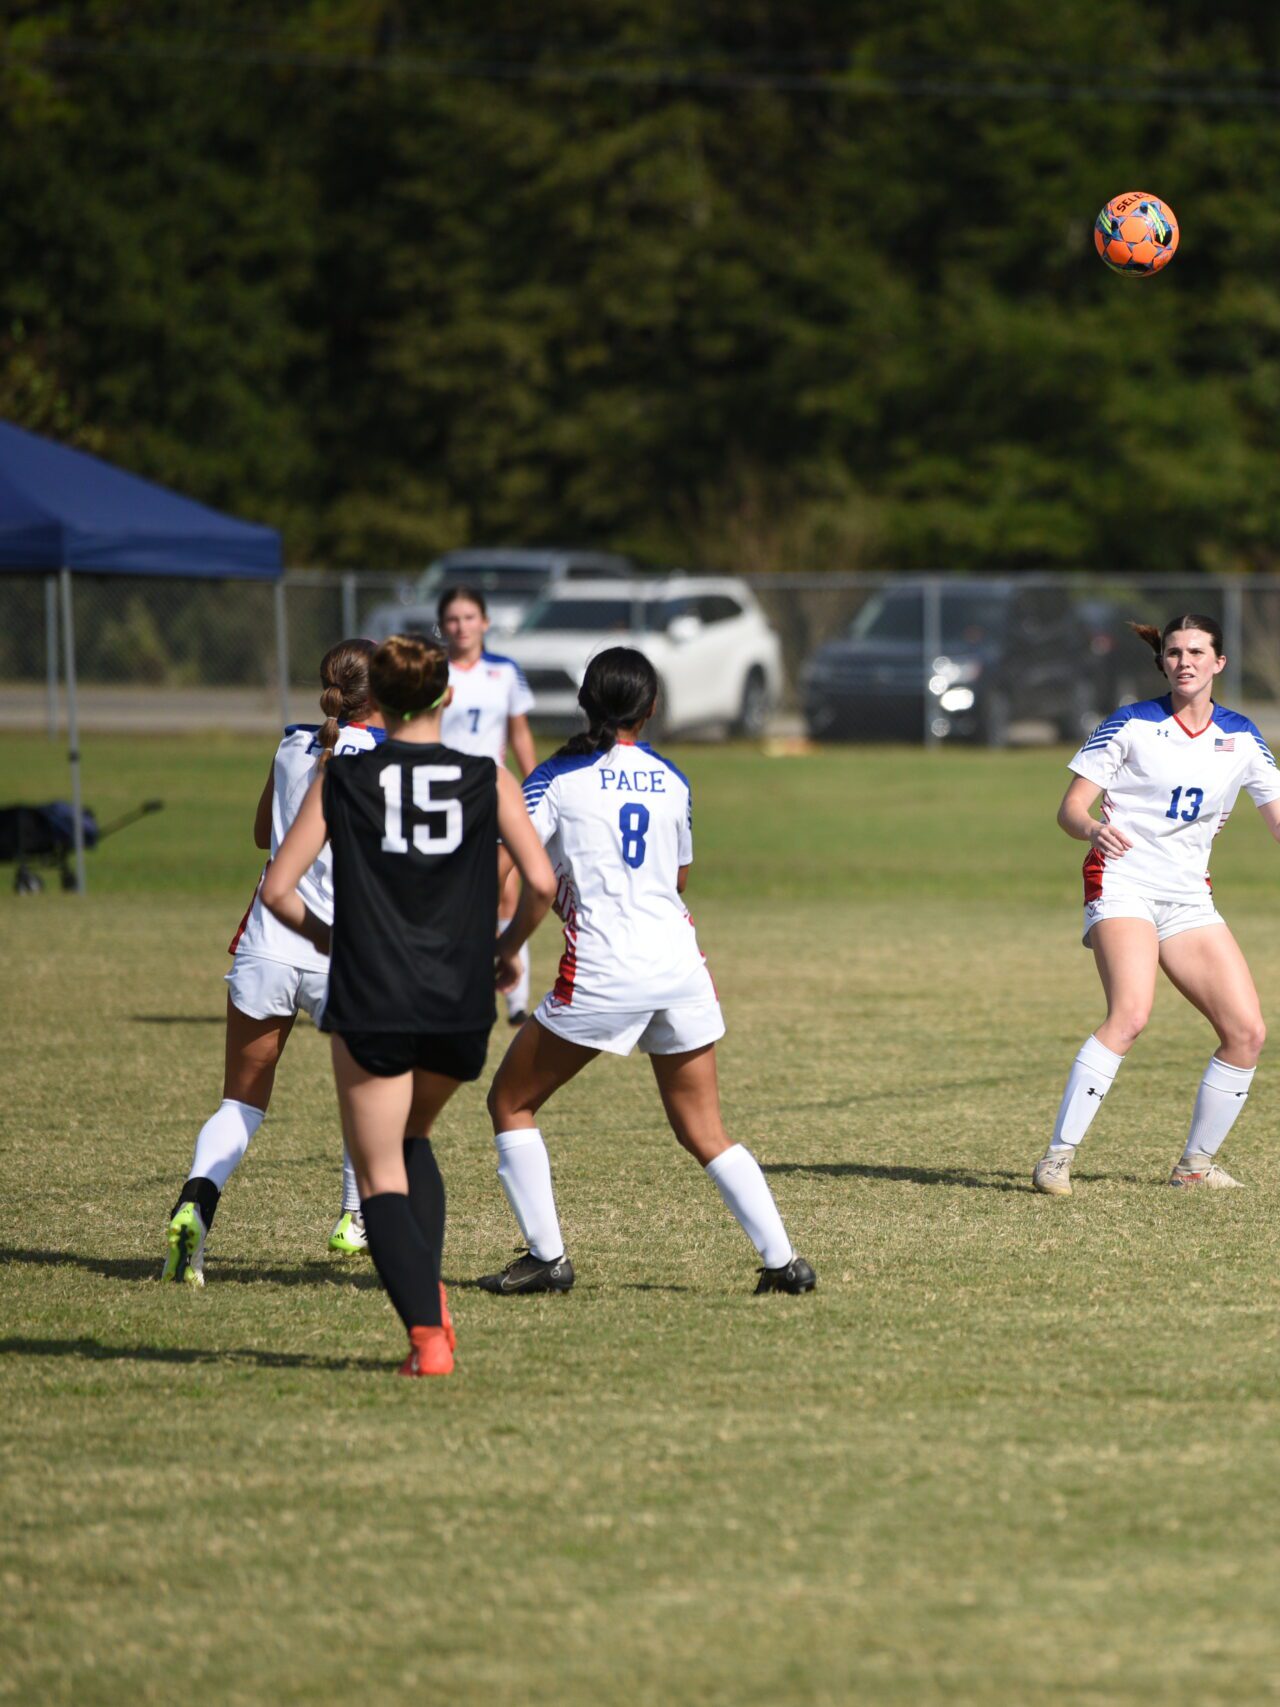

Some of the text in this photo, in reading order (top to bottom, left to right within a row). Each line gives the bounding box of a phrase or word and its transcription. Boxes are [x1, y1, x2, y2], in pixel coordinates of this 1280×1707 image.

[468, 708, 481, 733] 7
[599, 768, 667, 794] PACE
[379, 763, 463, 855] 15
[1165, 785, 1205, 822] 13
[618, 802, 650, 869] 8
